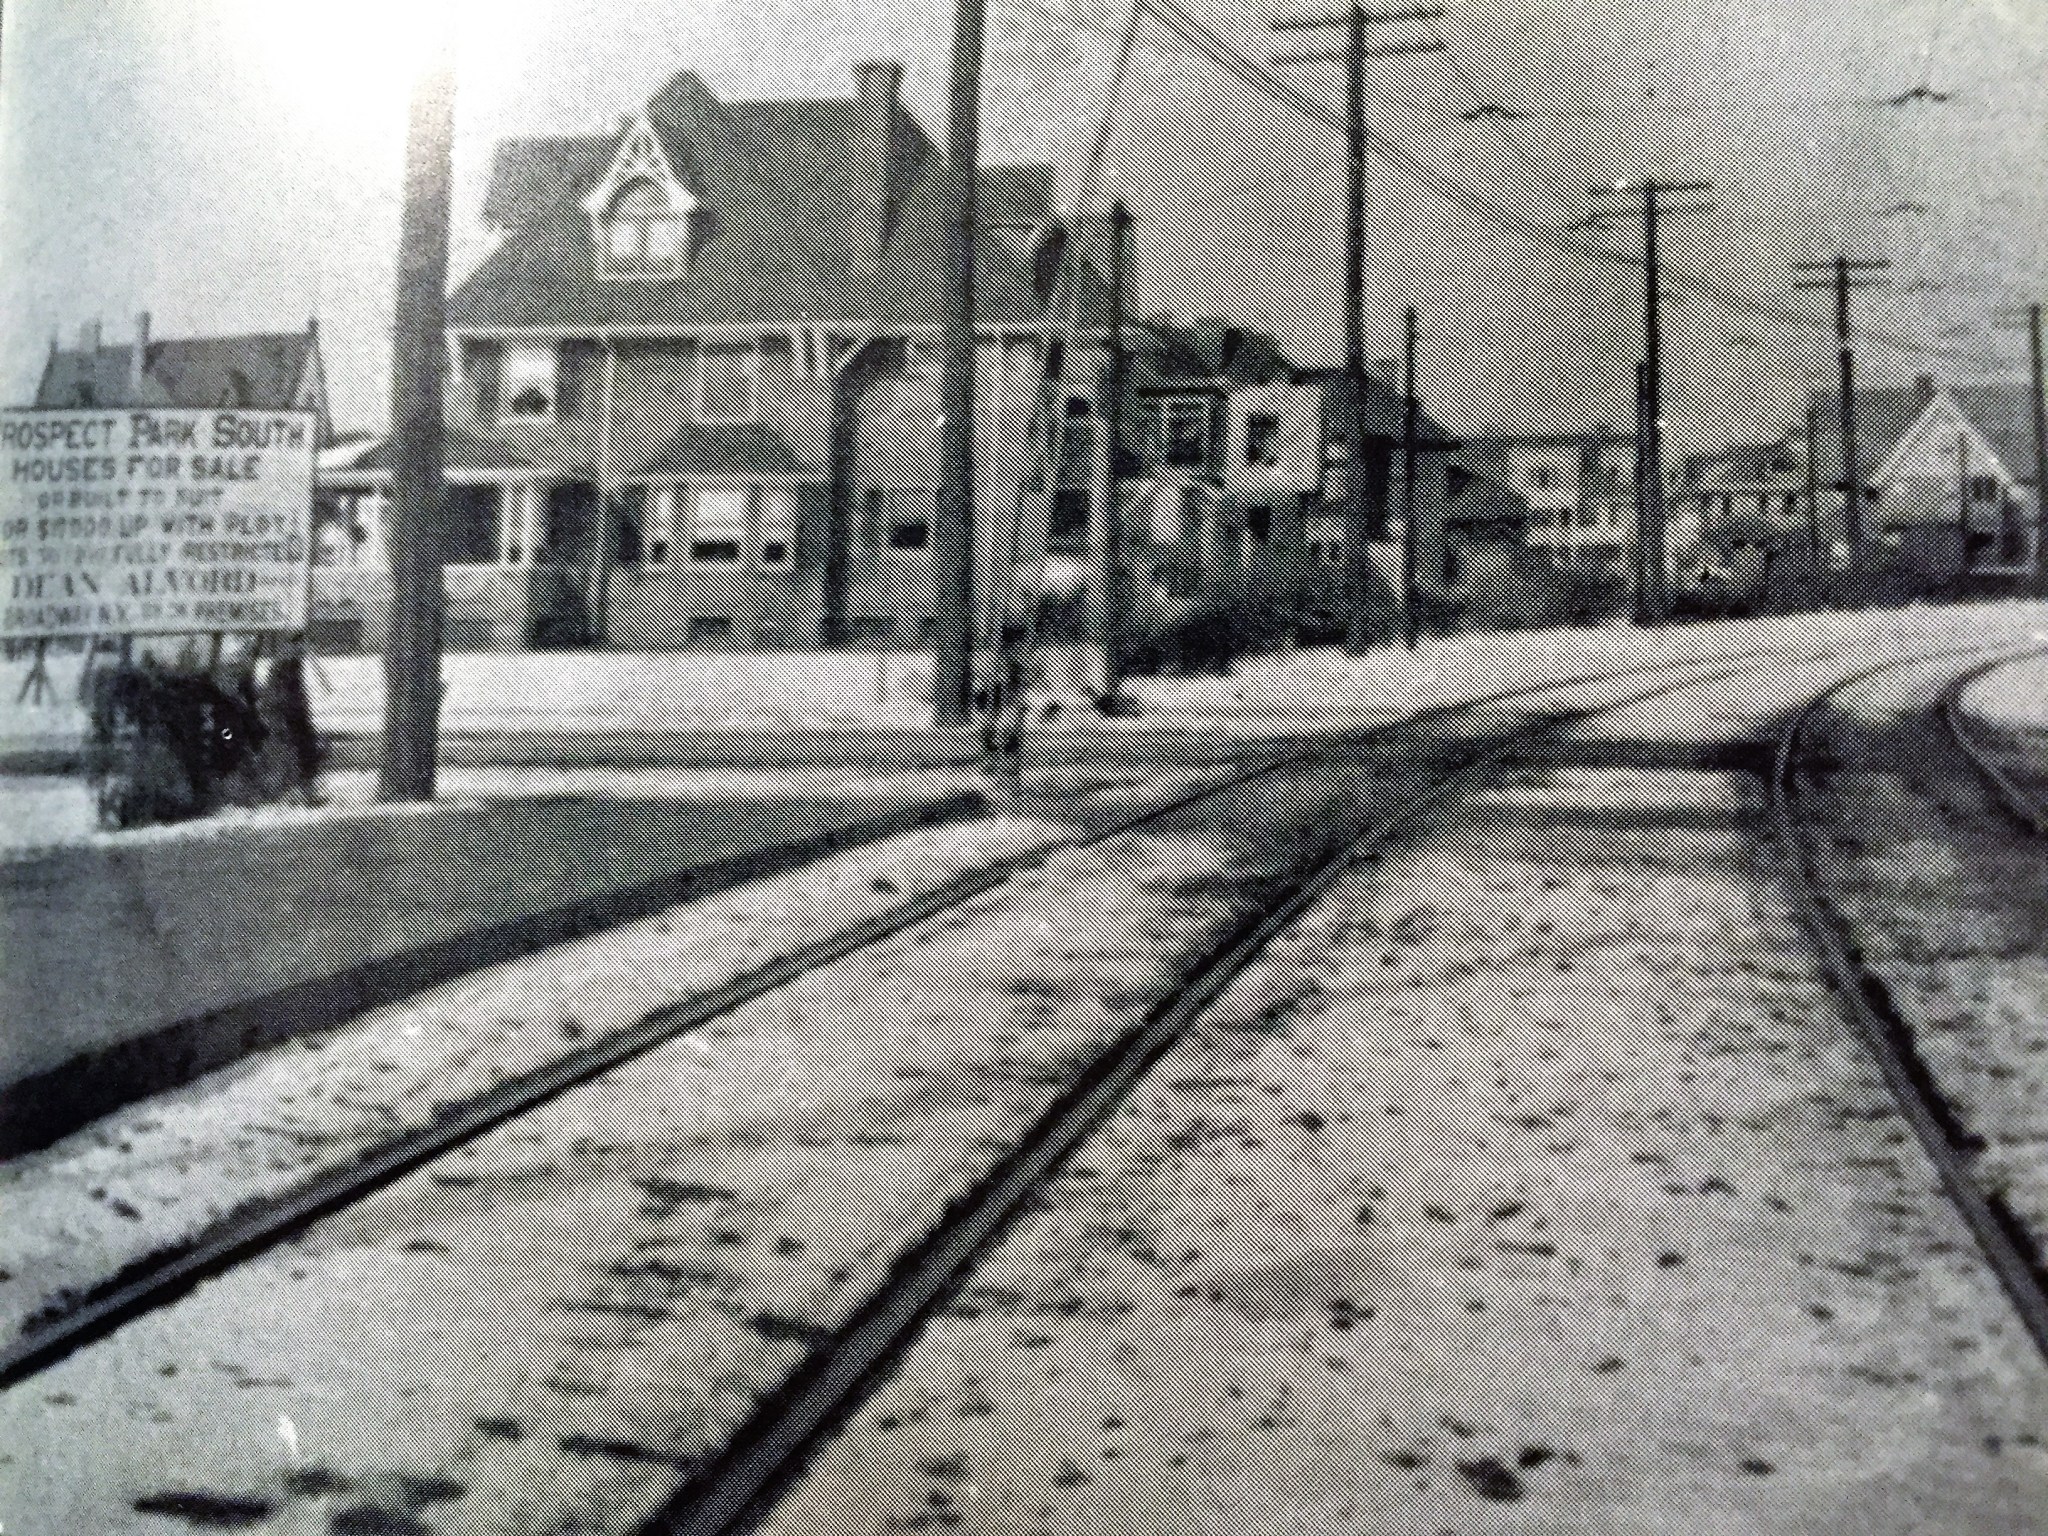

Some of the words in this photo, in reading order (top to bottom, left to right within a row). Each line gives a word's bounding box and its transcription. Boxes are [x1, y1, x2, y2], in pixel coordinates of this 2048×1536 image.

[1, 418, 115, 450] ROSPECT
[12, 456, 116, 481] HOUSES
[127, 455, 181, 480] FOR
[191, 455, 261, 480] SALE
